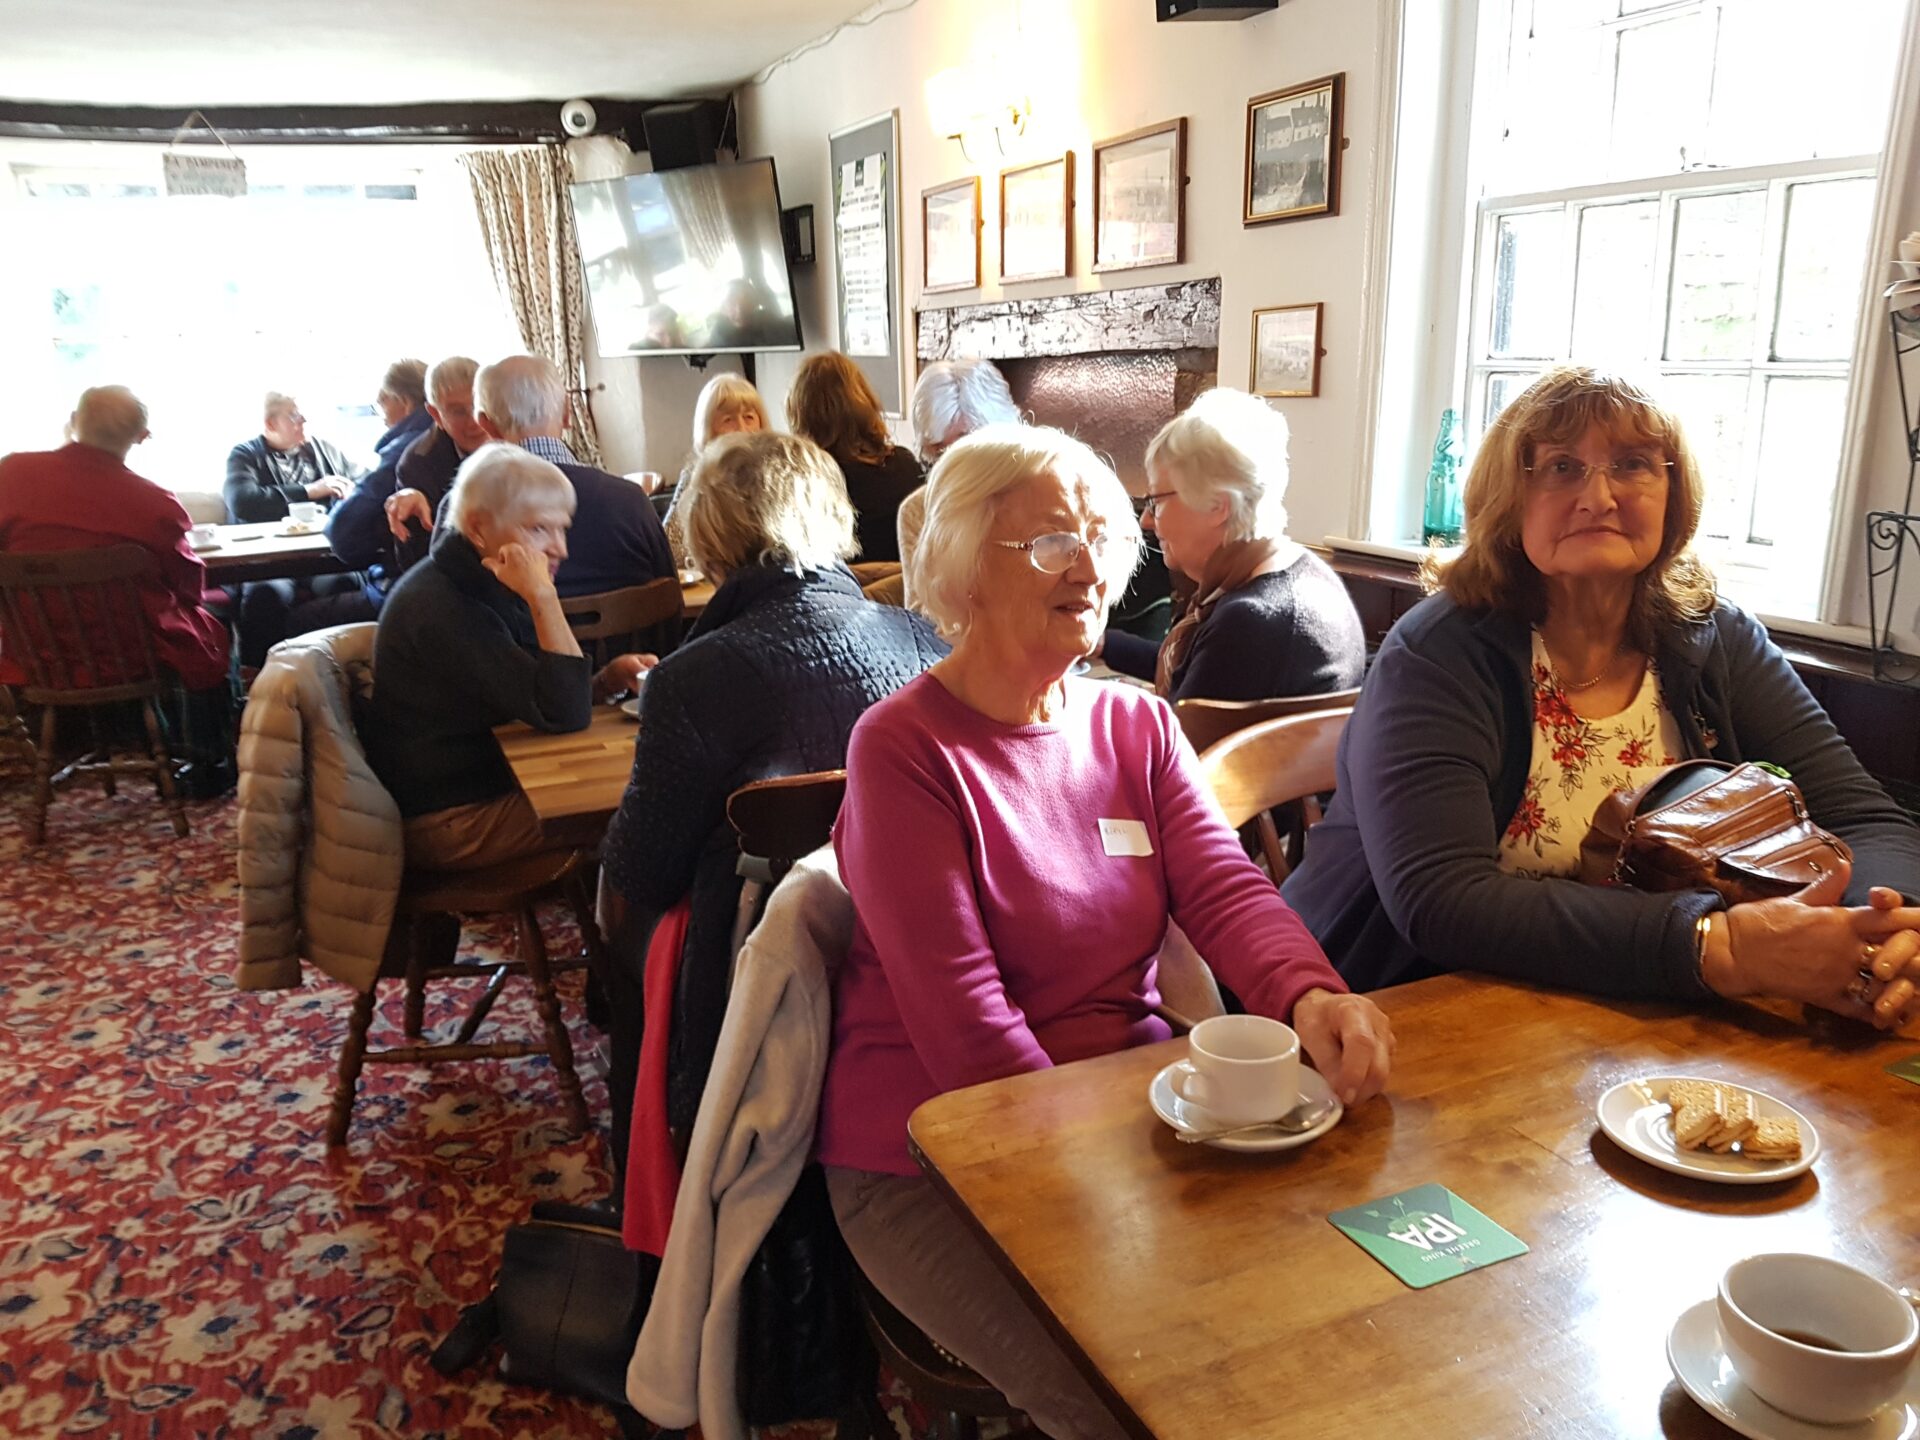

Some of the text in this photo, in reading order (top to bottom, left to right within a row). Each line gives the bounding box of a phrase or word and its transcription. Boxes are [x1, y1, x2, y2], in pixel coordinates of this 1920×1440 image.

[1388, 1214, 1467, 1250] IPA
[1421, 1239, 1481, 1262] GREENE KING
